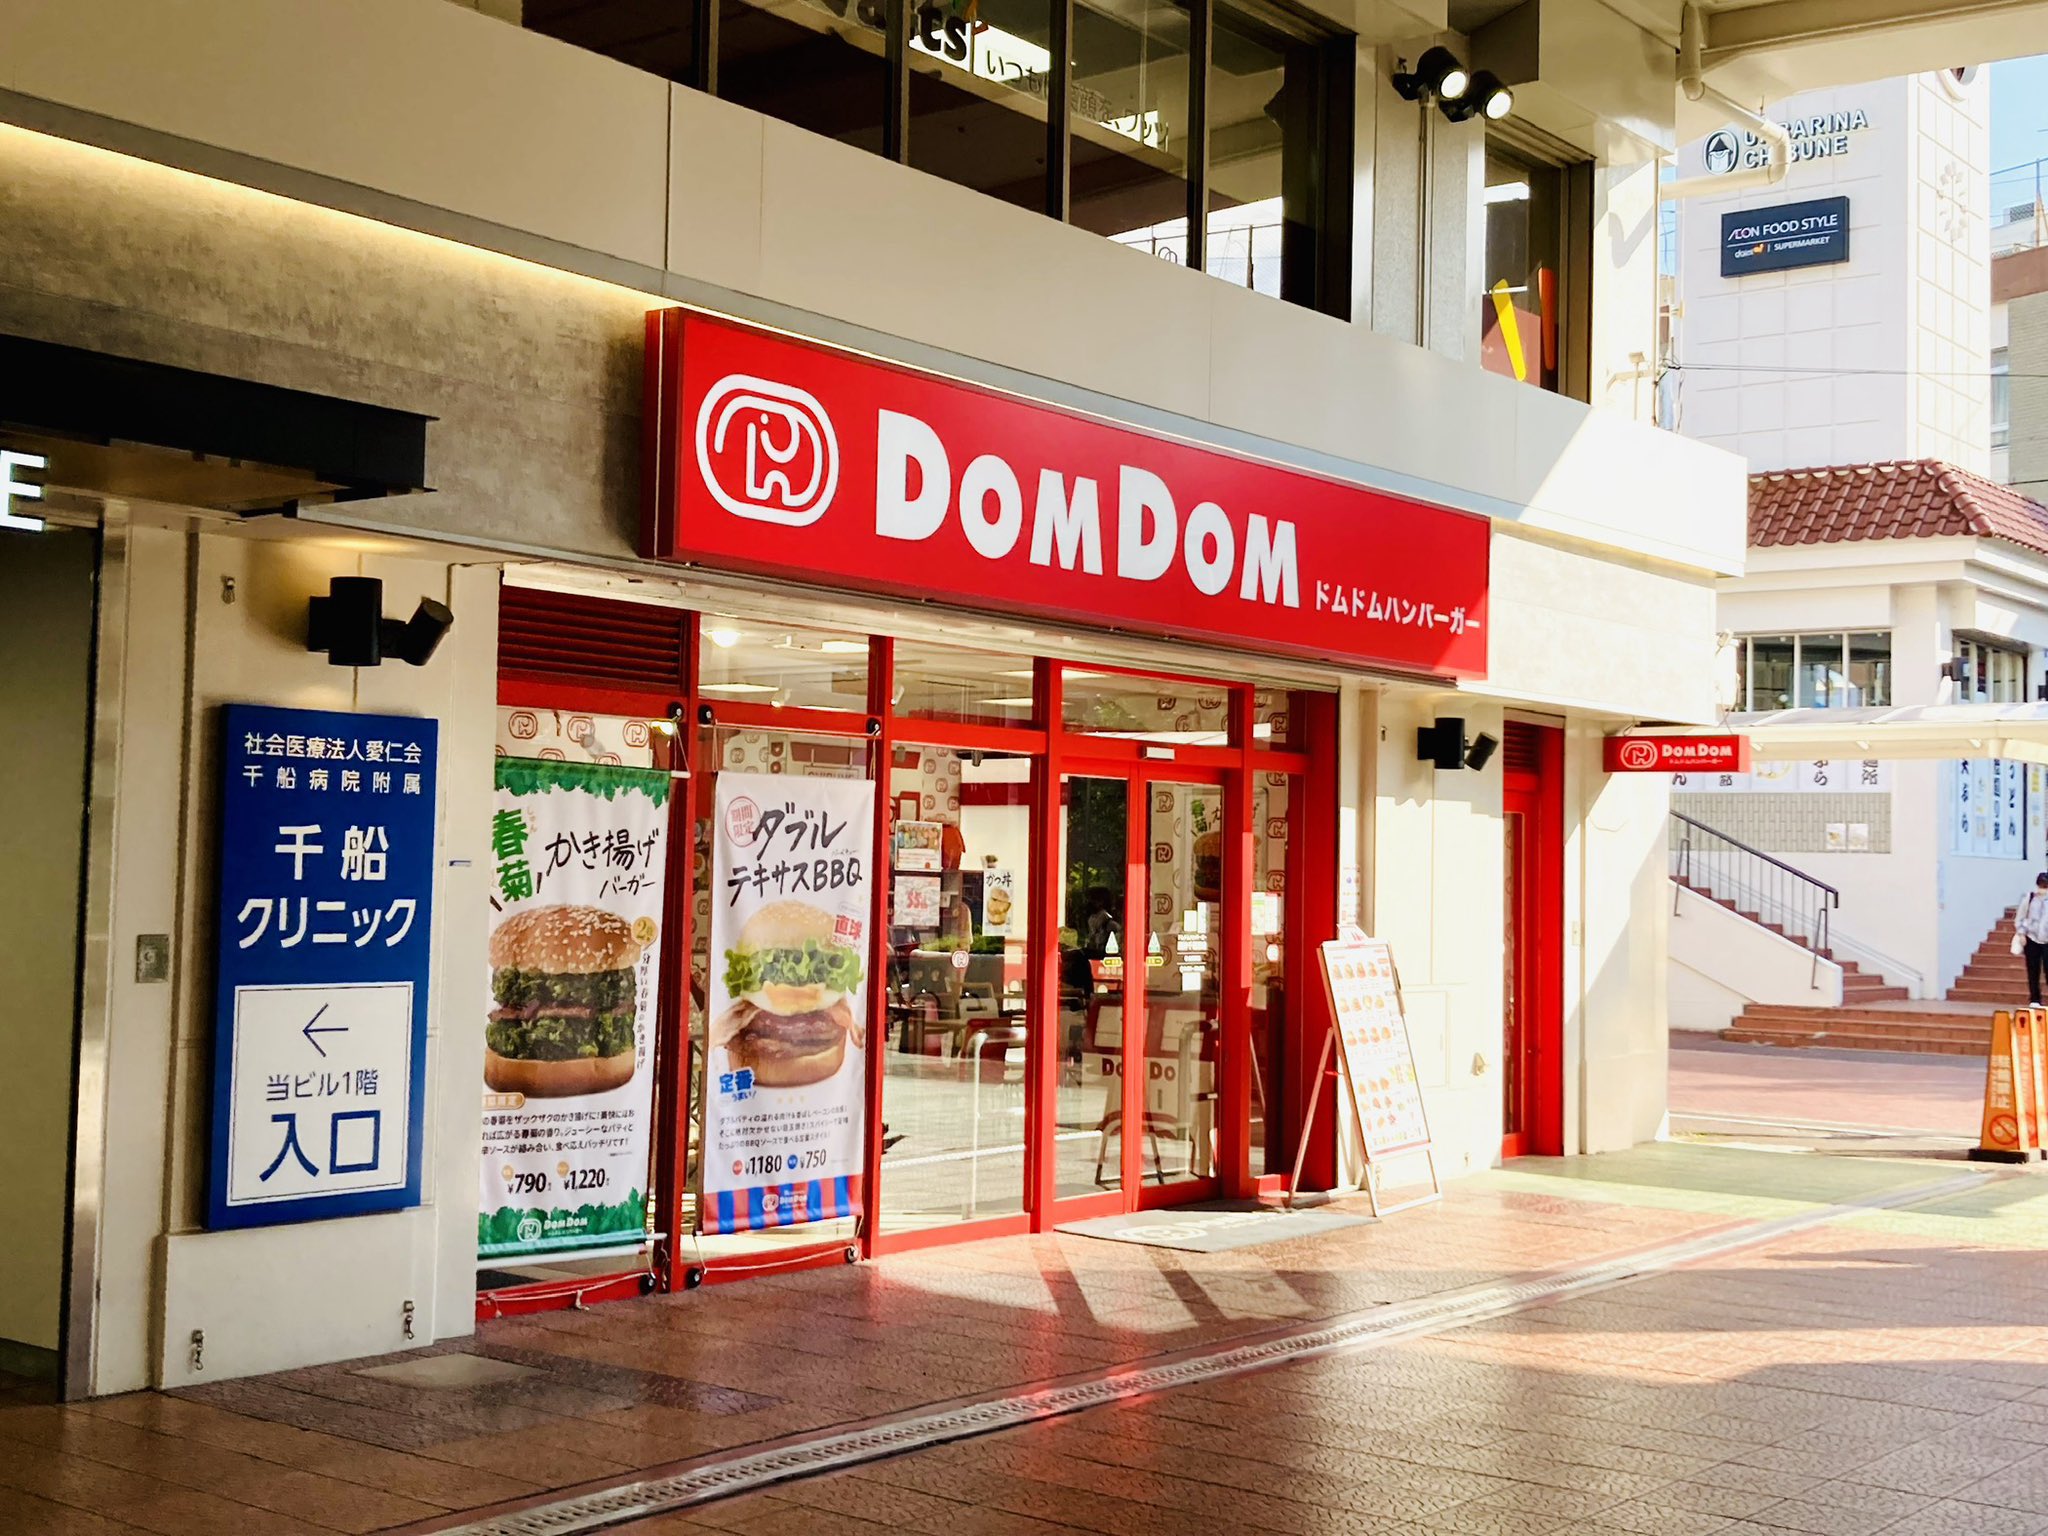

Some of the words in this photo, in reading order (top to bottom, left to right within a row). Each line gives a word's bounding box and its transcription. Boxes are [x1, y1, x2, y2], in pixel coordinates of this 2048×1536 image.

[1743, 136, 1849, 168] CHBUNE
[1762, 219, 1798, 236] FOOD
[1801, 213, 1838, 230] STYLE
[1773, 236, 1830, 251] SUPERMARKET
[1315, 579, 1481, 635] ドムドムハンバーガー
[244, 731, 422, 765] 社会医療法人愛仁会
[752, 801, 848, 861] ダブル
[275, 823, 390, 881] 千船
[491, 808, 533, 903] 春菊
[545, 828, 660, 877] かき揚げ
[599, 872, 656, 899] バーガー
[727, 857, 863, 908] テキサスBBQ
[237, 897, 417, 949] クリニック
[265, 1068, 379, 1102] 当ビル1階
[719, 1068, 756, 1094] 定番
[259, 1109, 381, 1183] 入口
[800, 1149, 827, 1170] ¥750
[507, 1172, 548, 1195] ¥790
